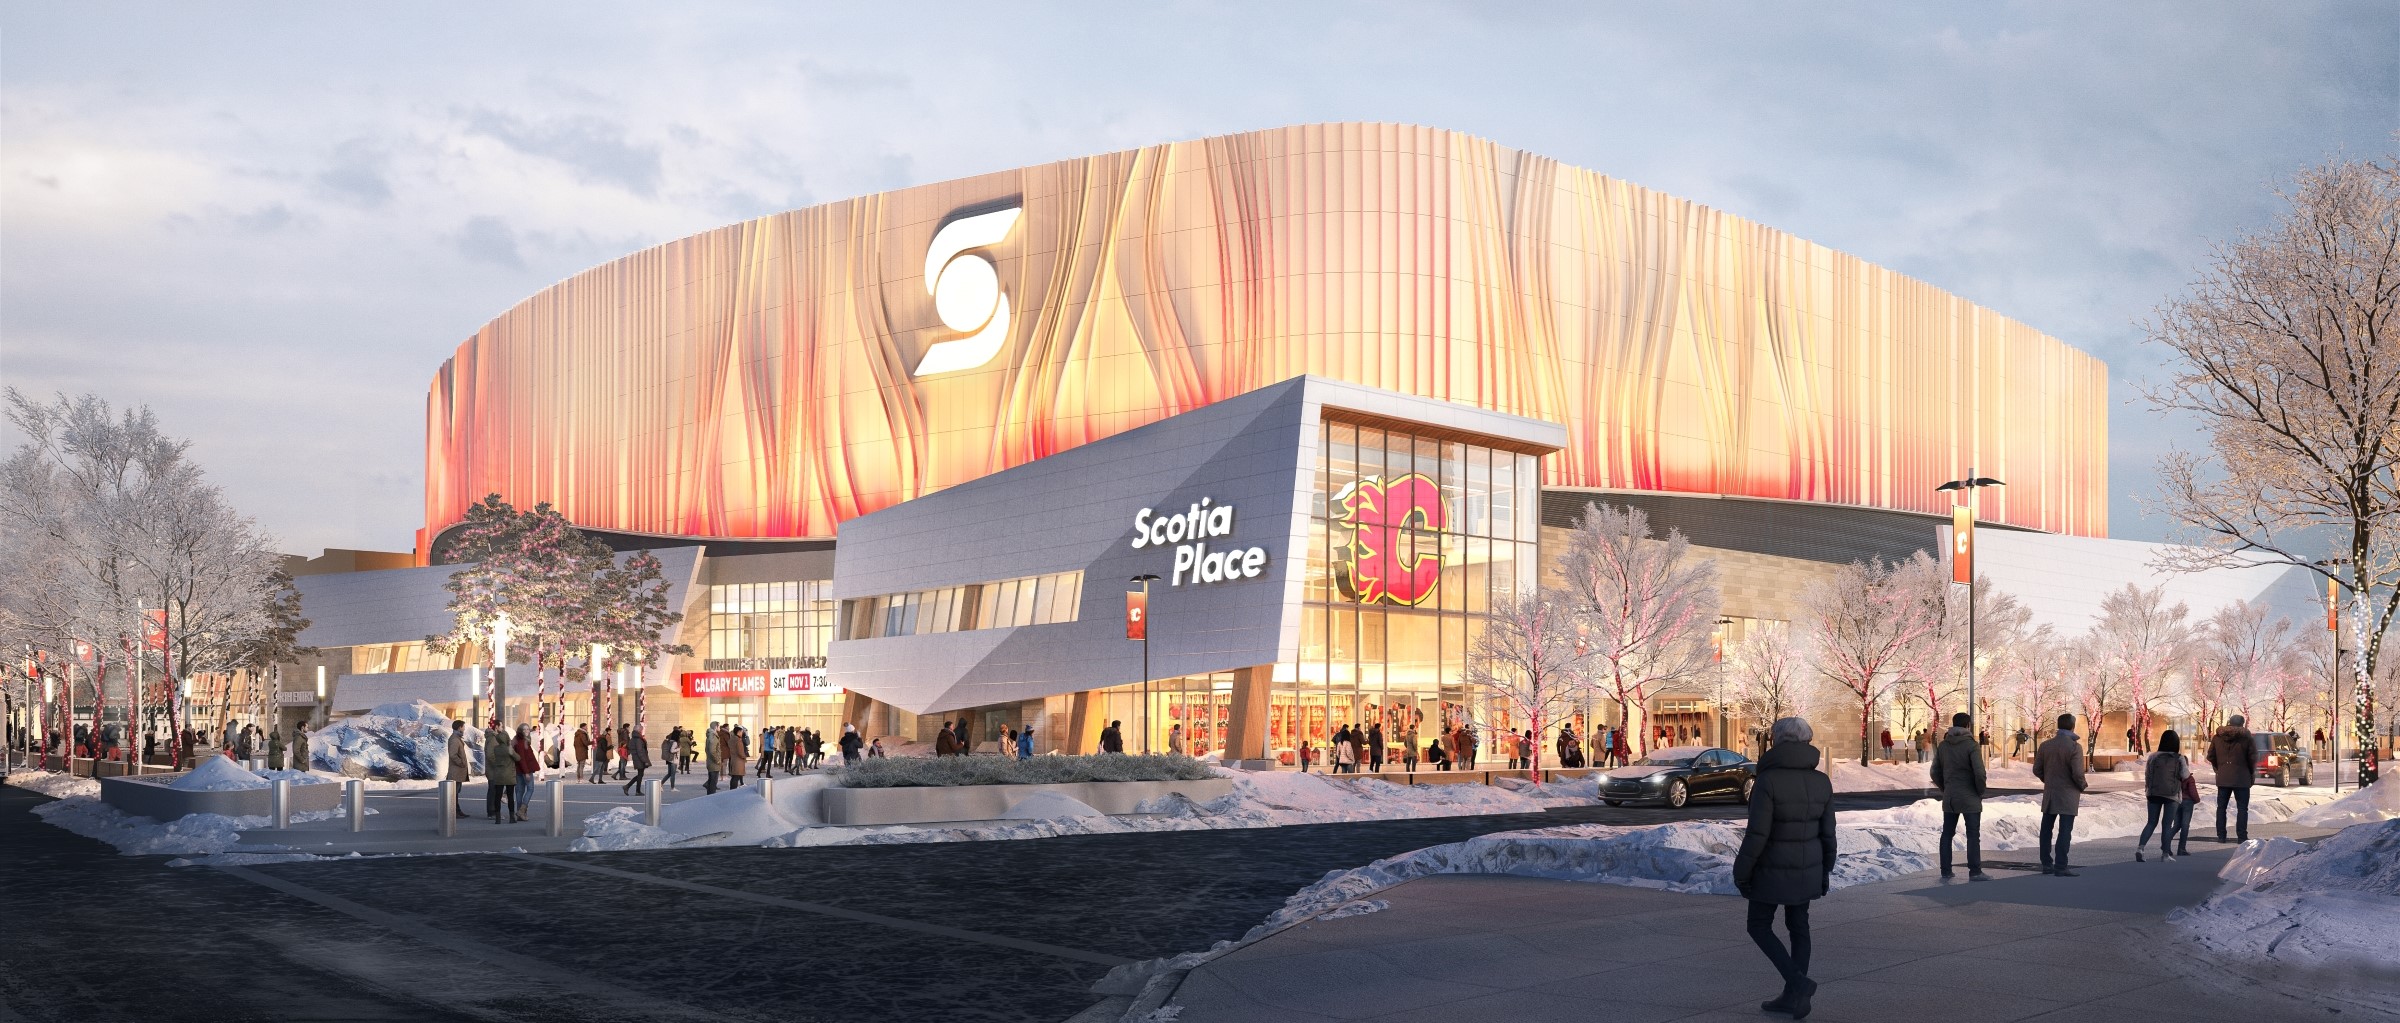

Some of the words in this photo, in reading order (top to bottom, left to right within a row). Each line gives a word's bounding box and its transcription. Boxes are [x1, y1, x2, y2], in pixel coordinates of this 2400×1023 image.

[1132, 497, 1233, 549] Scotia
[1172, 542, 1267, 586] Place
[759, 657, 792, 669] ENTRY
[695, 677, 731, 693] CALGARY
[733, 676, 765, 692] FLAMES
[773, 677, 786, 688] SAT
[789, 676, 804, 689] NOV
[804, 676, 809, 688] 1
[293, 691, 315, 702] ENTRY
